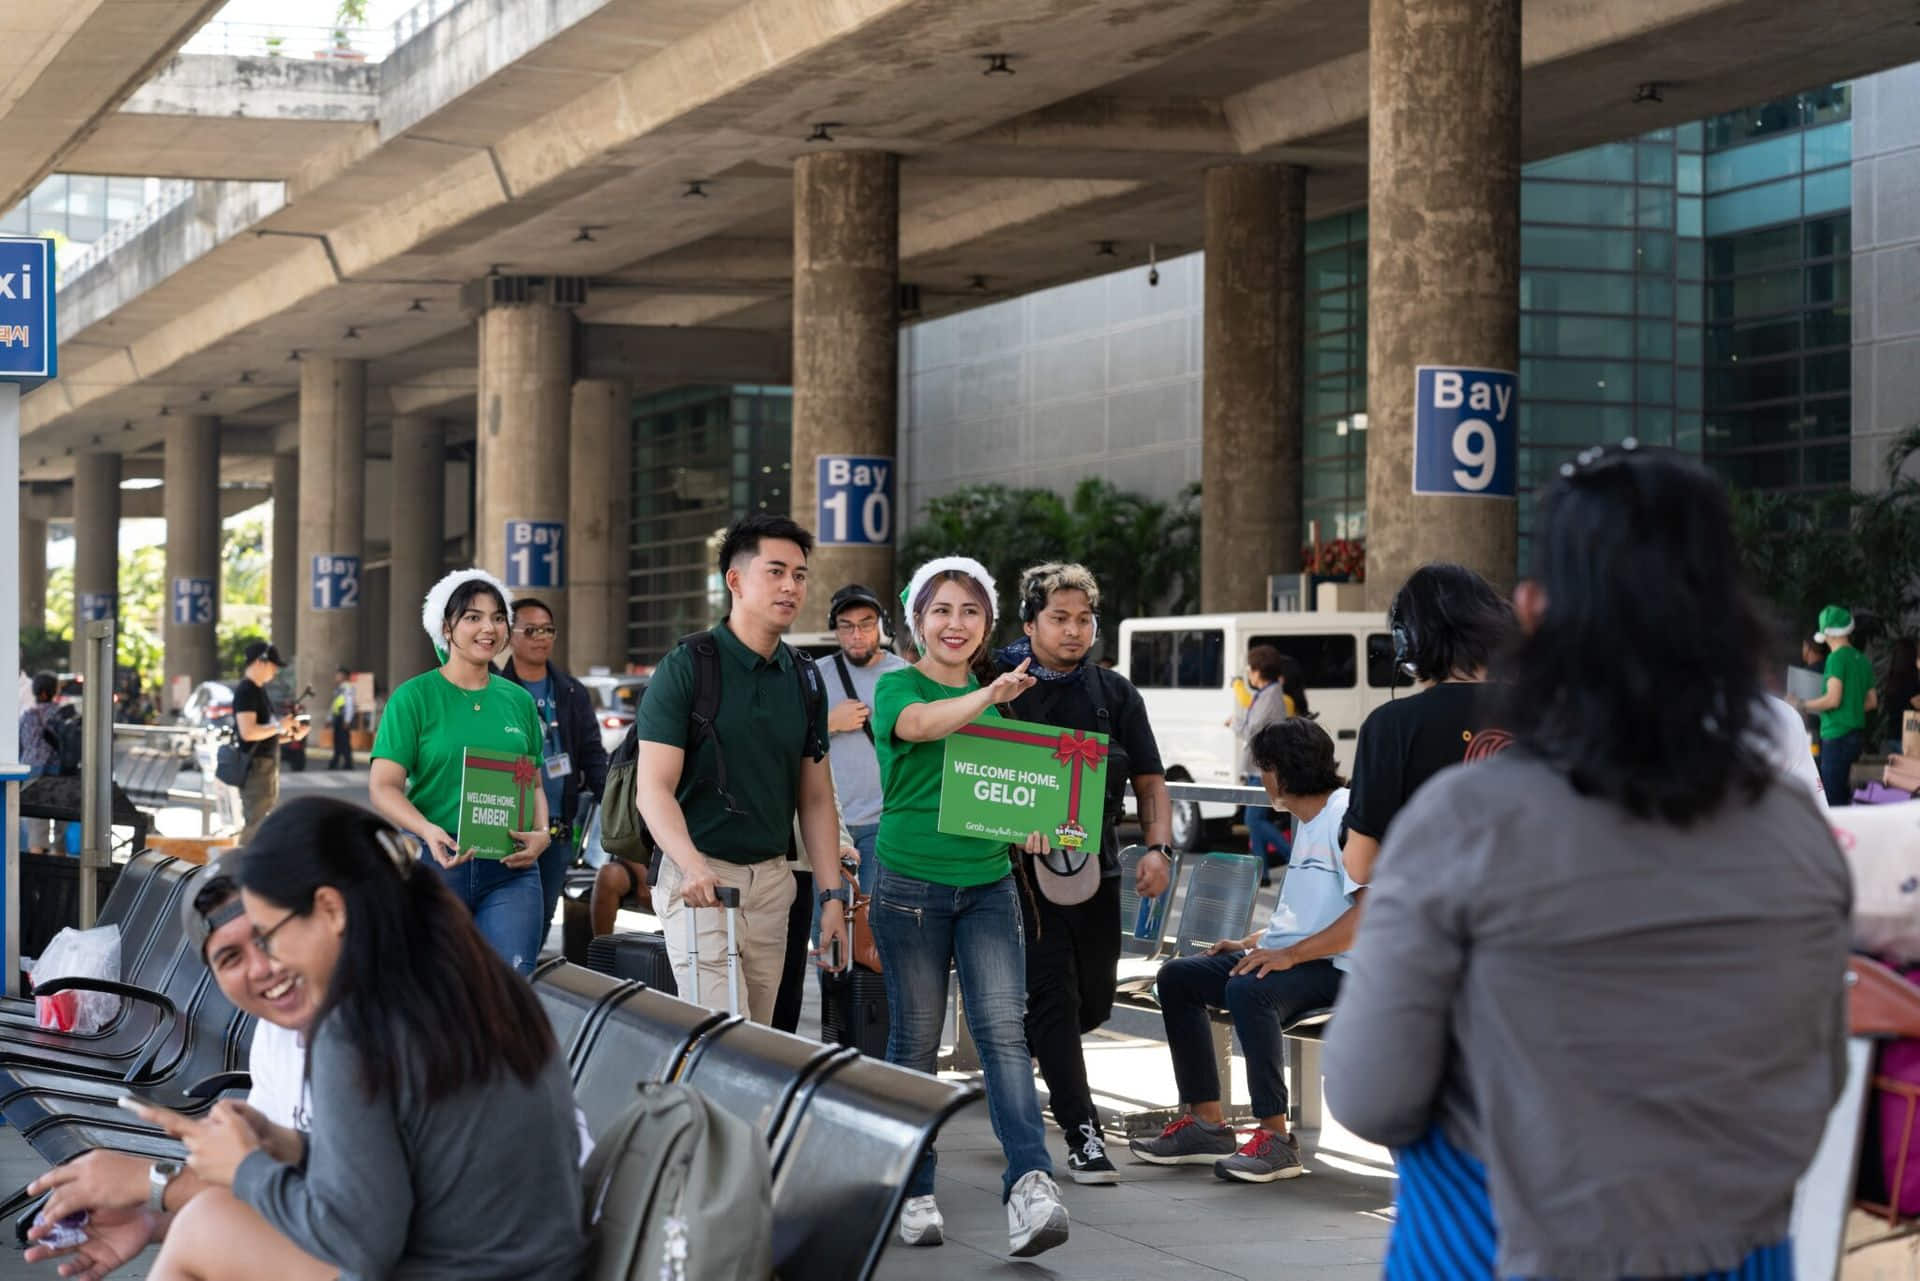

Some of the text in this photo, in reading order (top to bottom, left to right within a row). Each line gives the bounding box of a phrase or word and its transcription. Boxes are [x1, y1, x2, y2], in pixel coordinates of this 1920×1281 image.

[1434, 371, 1512, 422] Bay
[1452, 418, 1496, 491] 9
[828, 459, 887, 495] Bay
[823, 491, 890, 543] 10
[514, 524, 560, 552] Bay
[318, 557, 356, 578] Bay
[511, 546, 558, 586] 11
[315, 577, 358, 608] 12
[176, 596, 212, 622] 13
[954, 760, 1060, 790] WELCOME HOME,
[467, 791, 516, 808] WELCOME HOME,
[974, 780, 1036, 808] GELO!
[472, 806, 508, 827] EMBER!
[965, 821, 985, 832] Grab
